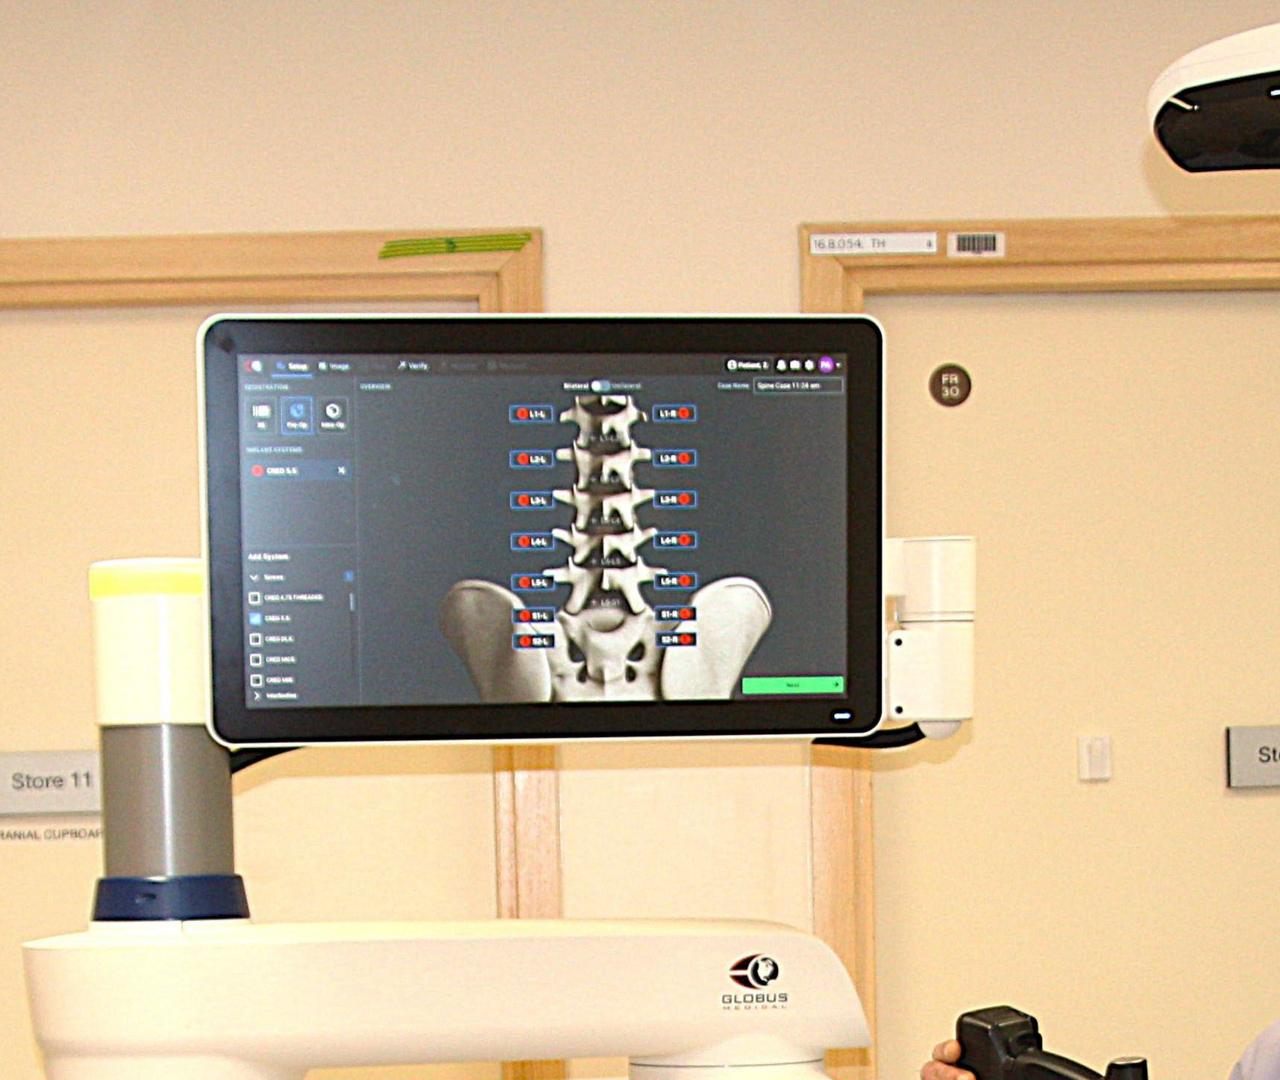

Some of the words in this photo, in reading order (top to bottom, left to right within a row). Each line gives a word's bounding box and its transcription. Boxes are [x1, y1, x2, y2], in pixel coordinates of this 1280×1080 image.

[871, 238, 887, 249] TH
[408, 361, 428, 371] Verify
[942, 373, 959, 384] FR
[941, 386, 960, 397] 30
[529, 410, 545, 419] L1-L
[659, 409, 677, 418] L1-R
[529, 455, 546, 464] L2-L
[248, 553, 261, 561] Add
[11, 772, 64, 790] Store
[71, 770, 91, 788] 11
[722, 993, 788, 1004] GLOBUS
